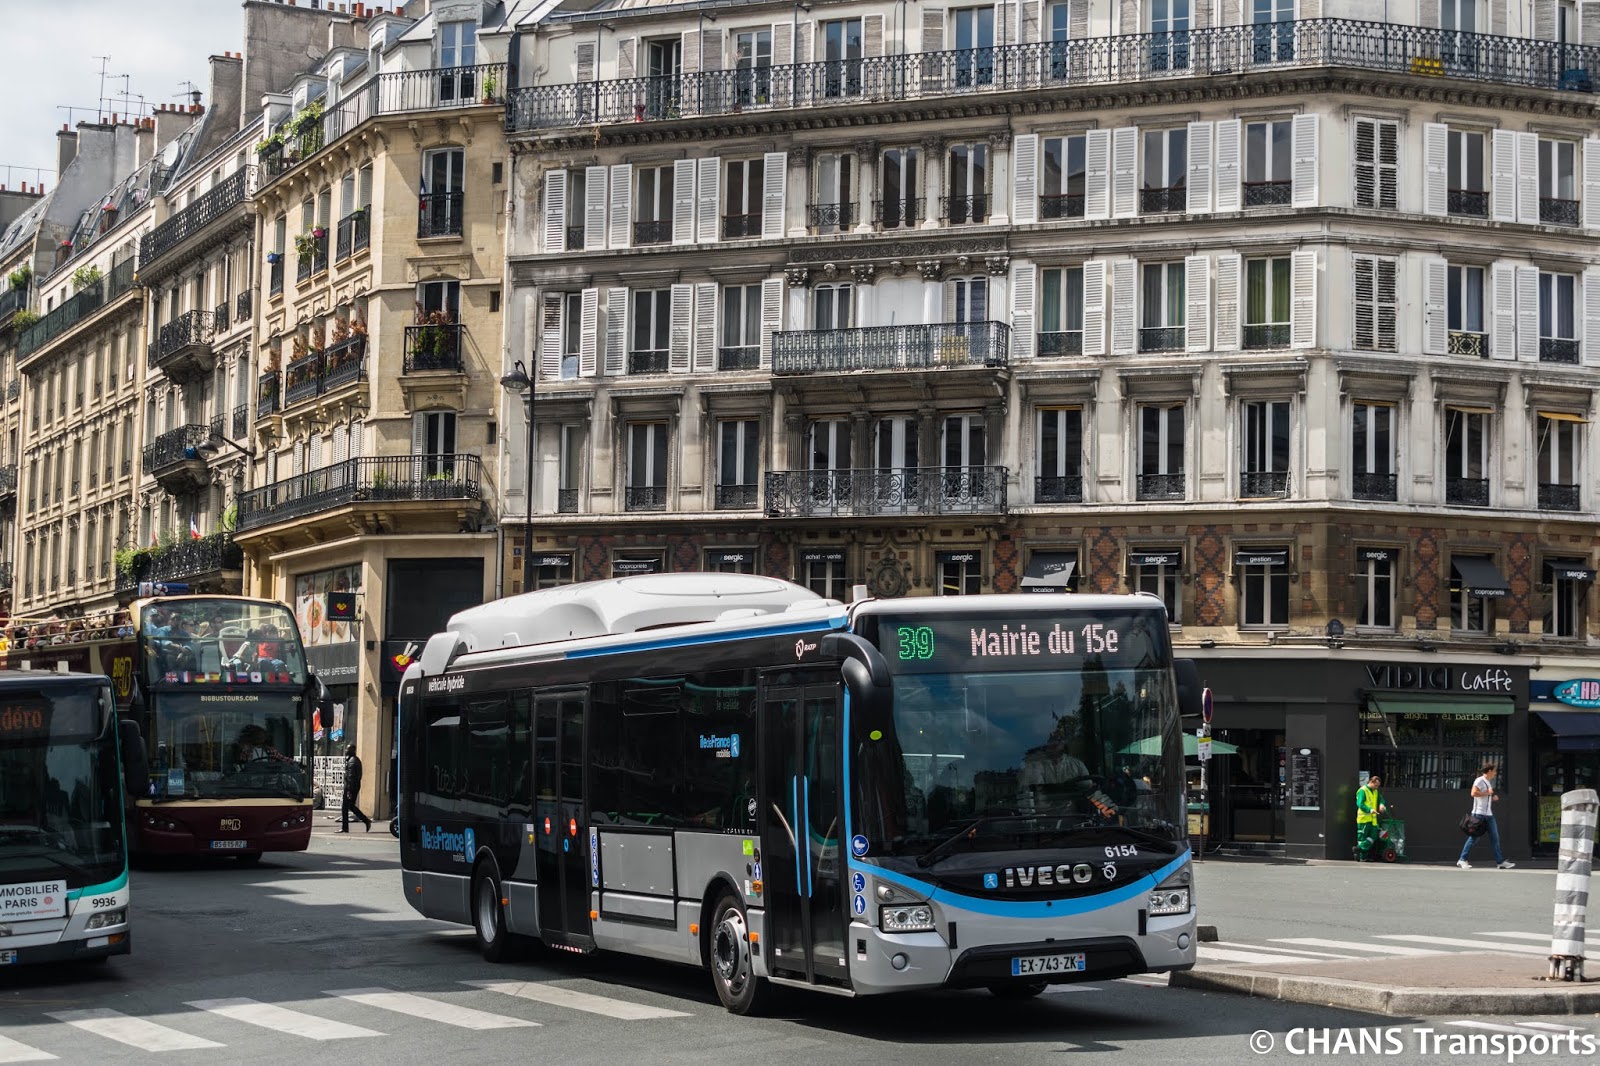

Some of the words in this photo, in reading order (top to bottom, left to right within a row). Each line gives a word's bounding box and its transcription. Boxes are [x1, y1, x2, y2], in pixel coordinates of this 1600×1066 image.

[543, 557, 561, 565] sergic
[723, 554, 743, 563] sergic
[952, 554, 973, 562] sergic
[1145, 555, 1167, 564] sergic
[1366, 551, 1388, 560] sergic
[1566, 570, 1588, 580] sergic
[898, 626, 935, 660] 39
[971, 624, 1041, 657] Mairie
[1048, 623, 1075, 654] du
[1081, 623, 1119, 653] 15e
[804, 643, 817, 651] RATP
[447, 674, 465, 693] hybride
[1366, 664, 1454, 689] VIDICI
[1461, 668, 1513, 691] Caffè
[0, 705, 43, 731] déro
[1455, 712, 1490, 721] barista
[1104, 845, 1138, 858] 6154
[1005, 863, 1093, 888] IVECO
[5, 897, 38, 909] PARIS
[92, 896, 117, 909] 9936
[1020, 956, 1077, 973] EX-743-ZK
